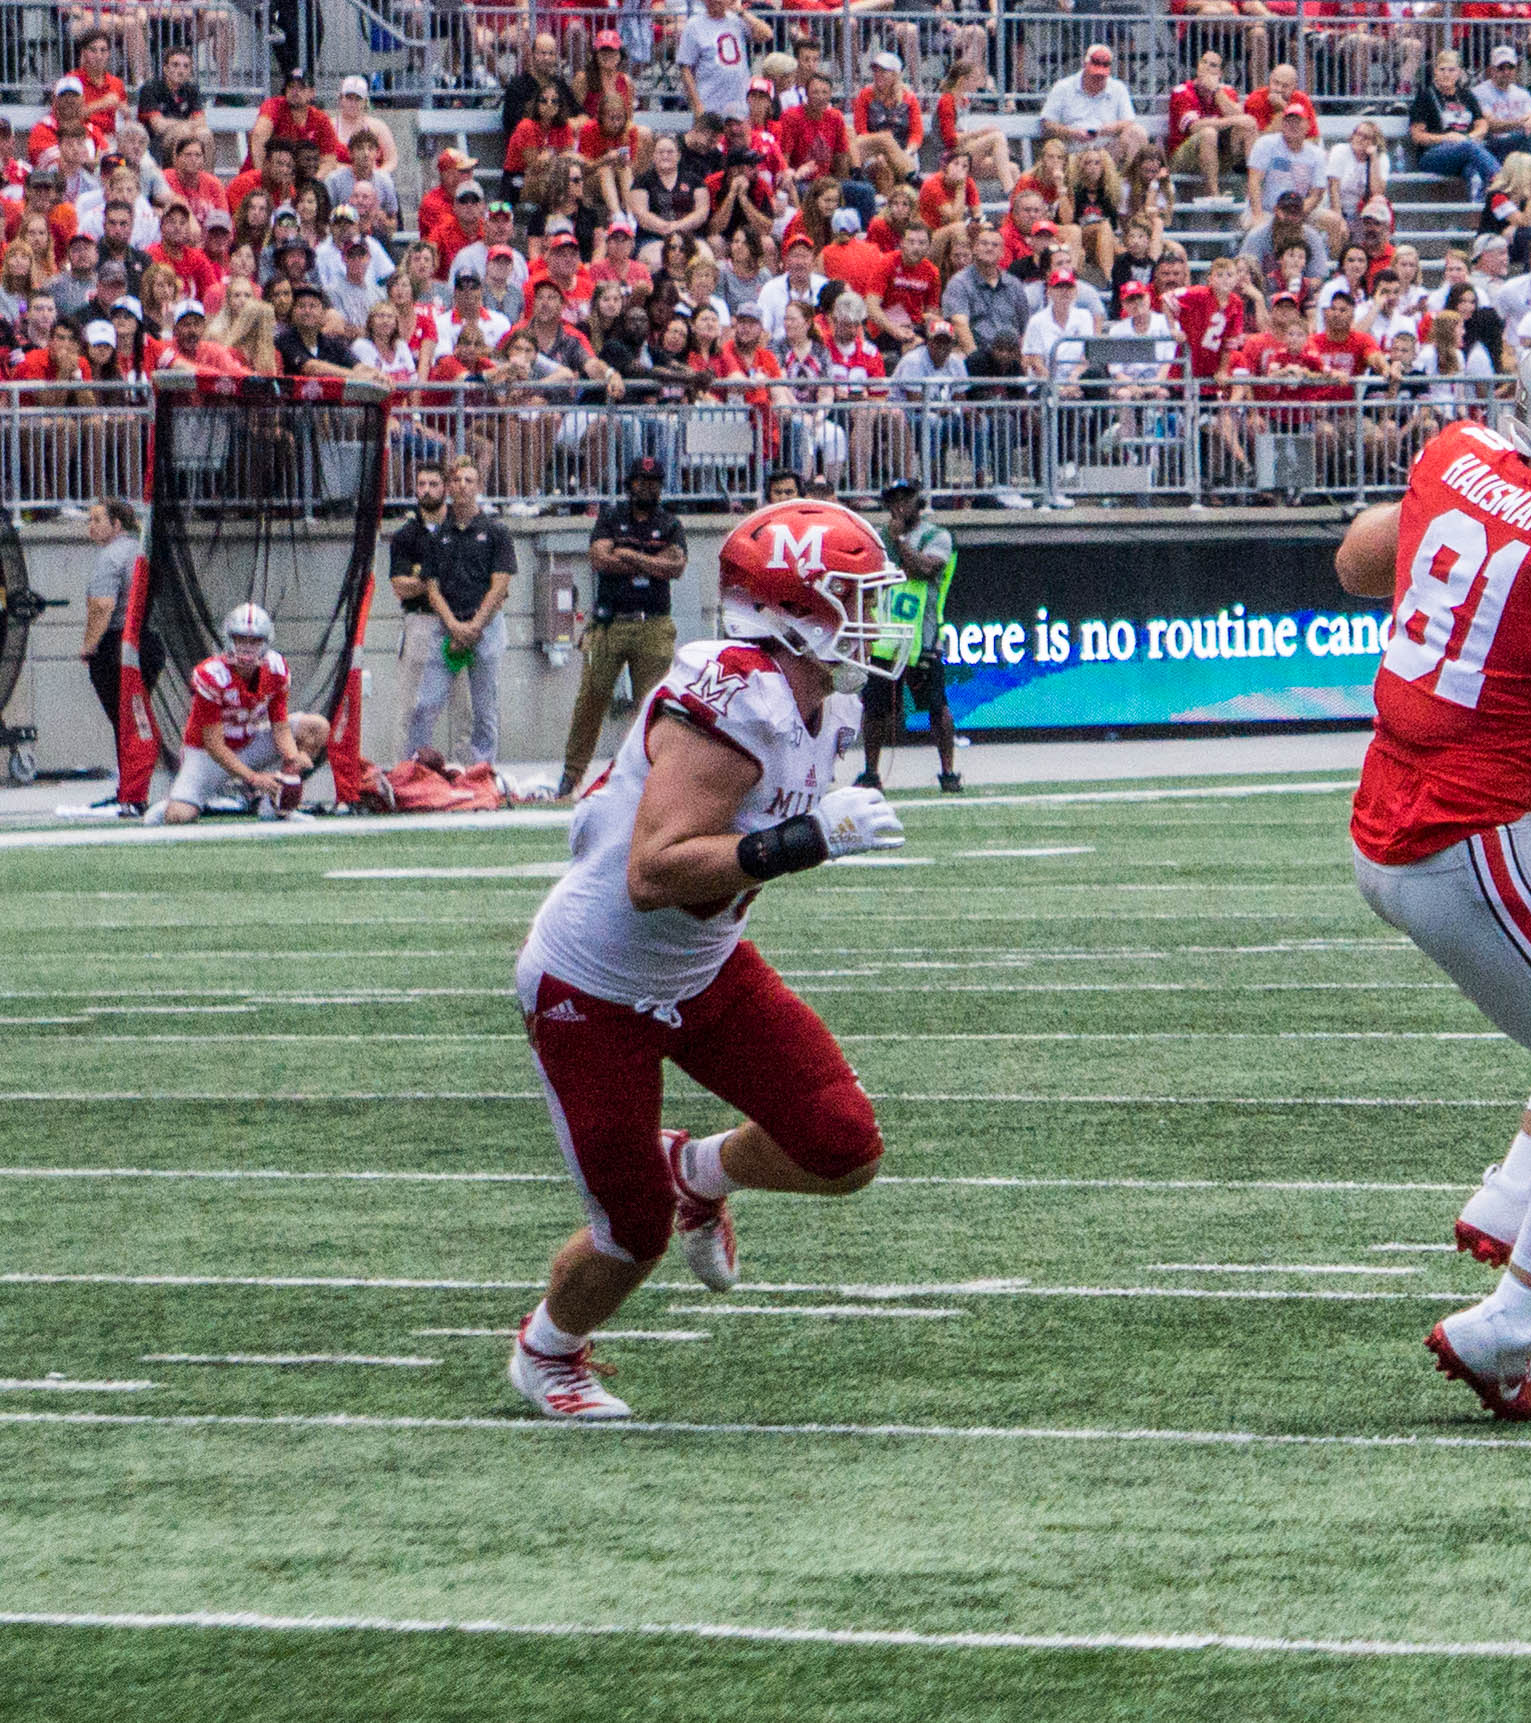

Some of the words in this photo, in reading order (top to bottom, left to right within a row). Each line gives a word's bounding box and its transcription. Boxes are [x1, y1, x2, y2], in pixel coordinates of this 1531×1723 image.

[1201, 311, 1227, 352] 2
[766, 524, 829, 573] M
[1037, 606, 1071, 663] is
[1081, 618, 1137, 661] no
[1148, 604, 1298, 660] routine
[1383, 508, 1531, 710] 81
[684, 659, 749, 717] M
